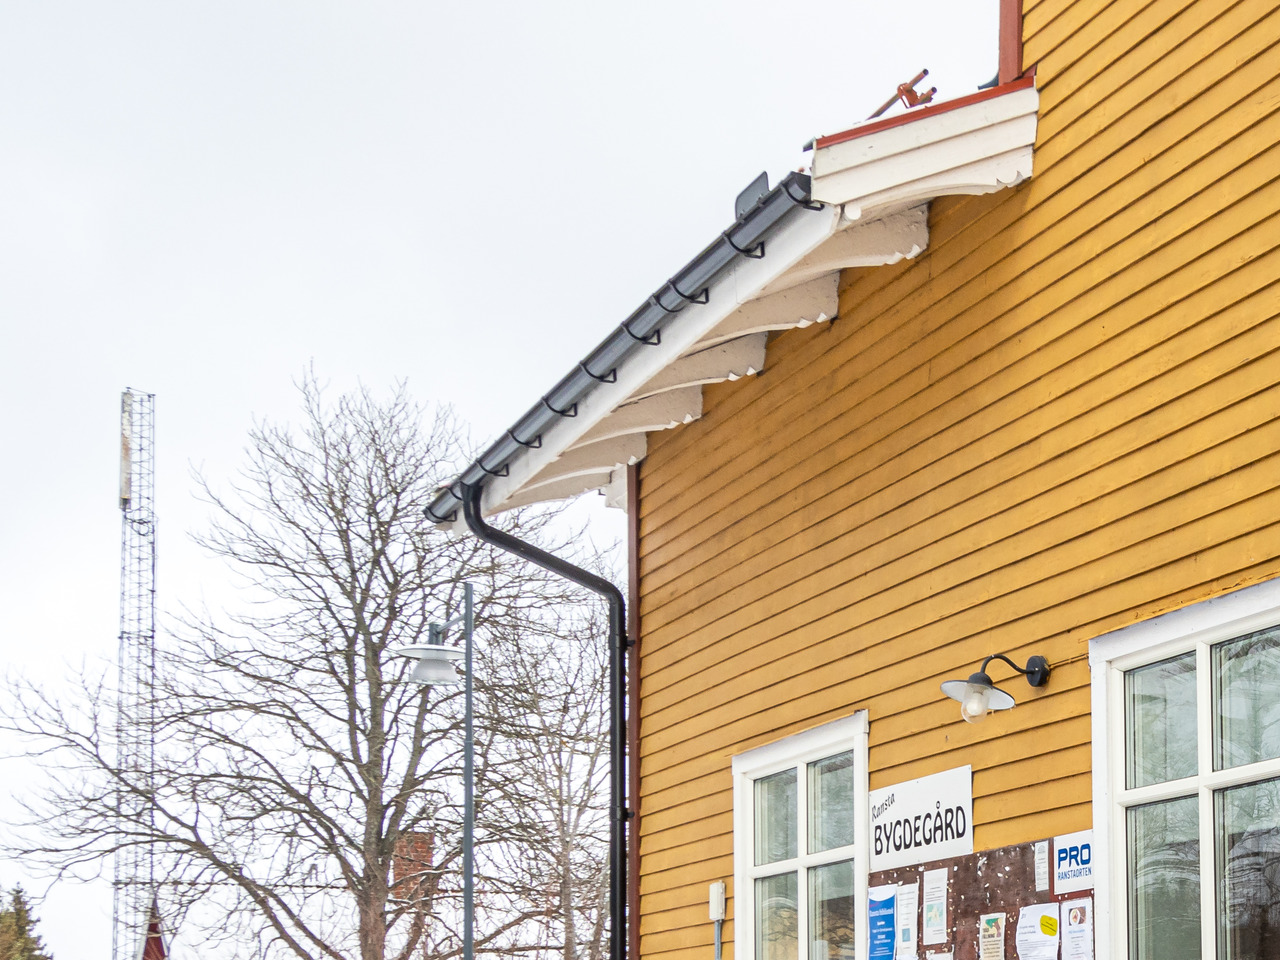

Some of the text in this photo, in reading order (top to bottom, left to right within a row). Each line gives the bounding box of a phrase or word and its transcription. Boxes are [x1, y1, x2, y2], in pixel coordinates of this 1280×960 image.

[871, 793, 896, 822] Ransta
[874, 800, 967, 856] BYGDEGÅRD
[1058, 843, 1091, 870] PRO
[1058, 867, 1092, 881] RANSTAORTEN
